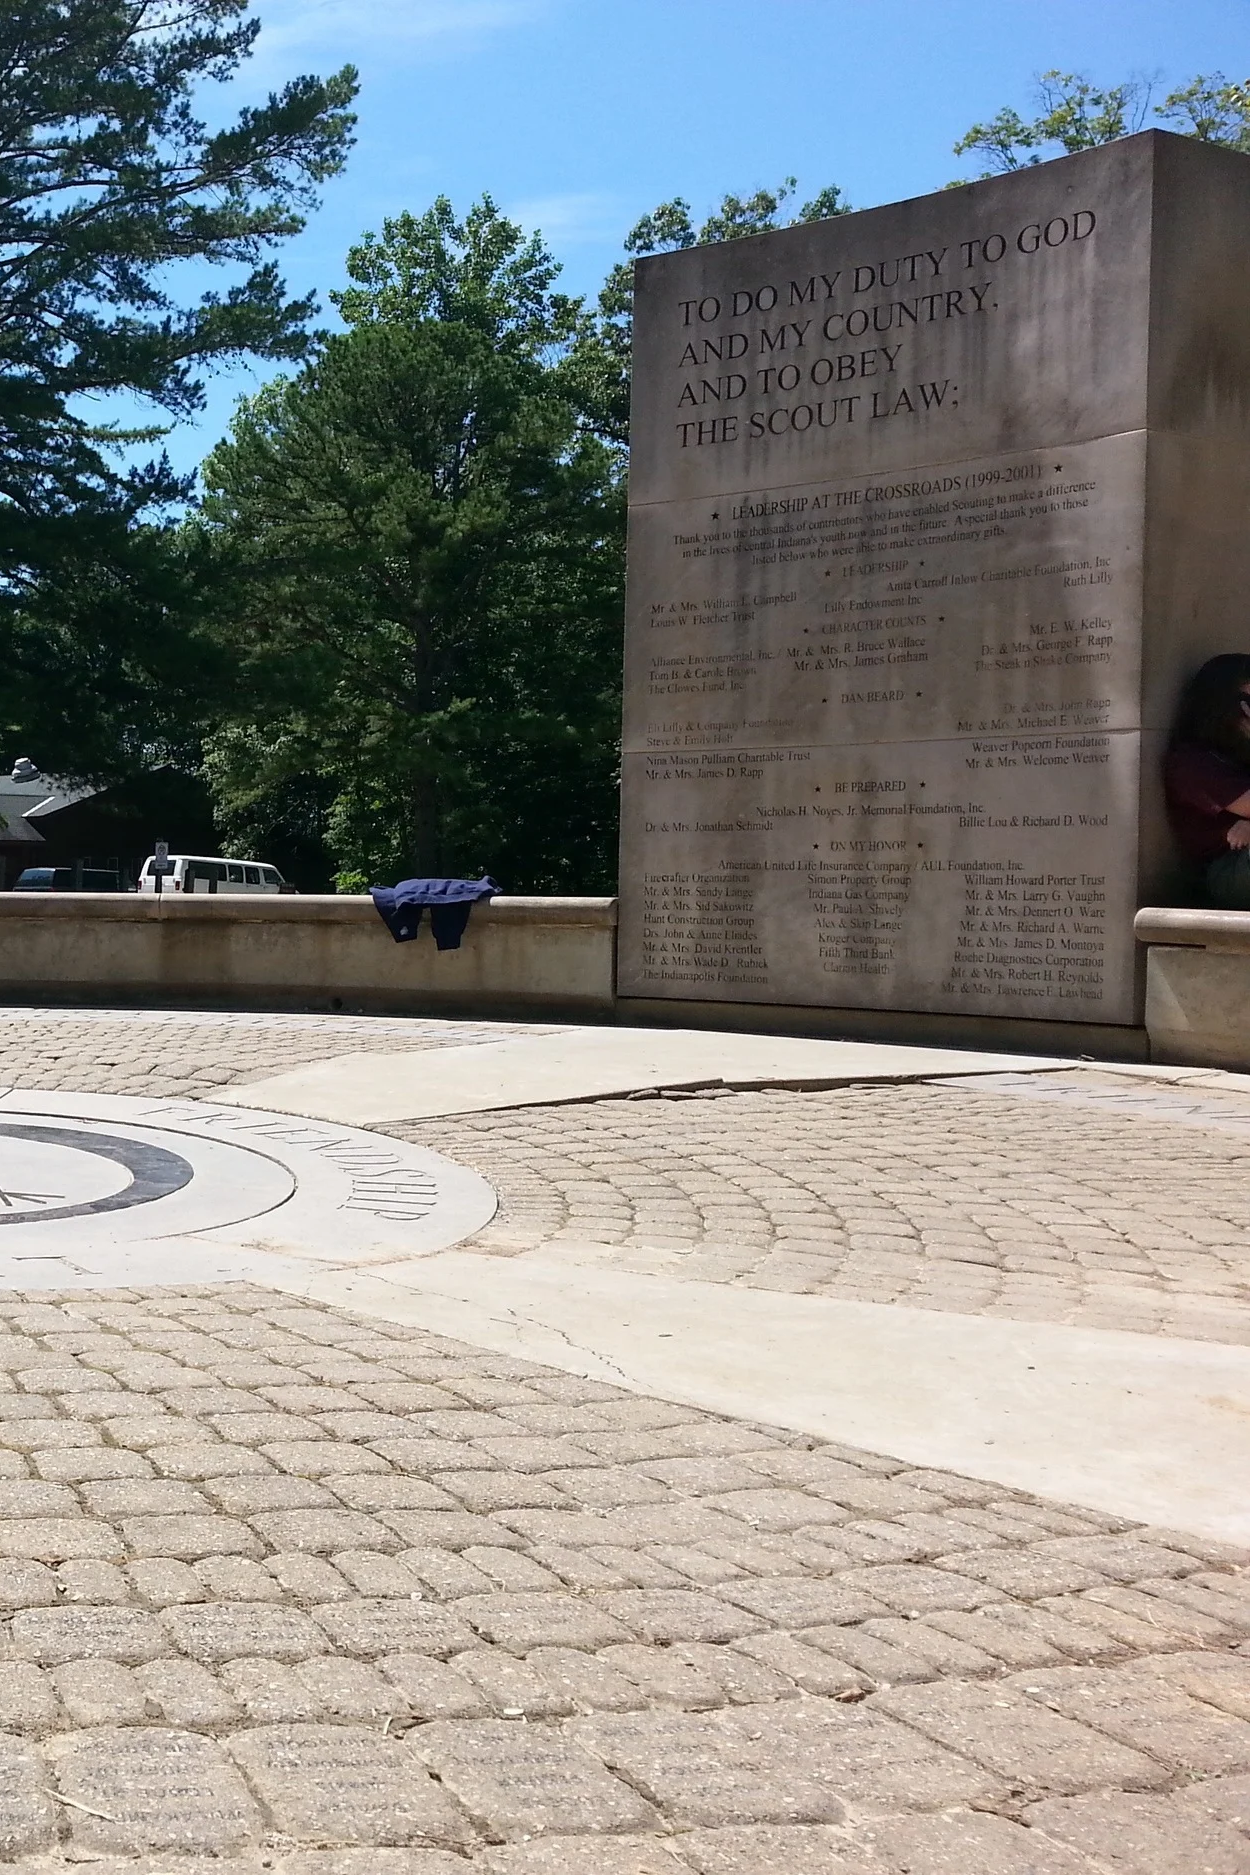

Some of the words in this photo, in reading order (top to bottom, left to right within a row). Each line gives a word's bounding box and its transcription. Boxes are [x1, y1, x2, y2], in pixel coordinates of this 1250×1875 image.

[677, 296, 720, 327] TO
[731, 284, 778, 317] DO
[789, 270, 841, 307] MY
[853, 246, 948, 294] DUTY
[960, 233, 1006, 269] TO
[1016, 209, 1096, 254] GOD
[677, 332, 749, 368] AND
[758, 319, 812, 354] MY
[822, 280, 998, 342] COUNTRY,
[676, 373, 747, 408] AND
[756, 363, 801, 394] TO
[810, 342, 903, 386] OBEY
[675, 415, 738, 448] THE
[749, 395, 860, 439] SCOUT
[869, 378, 958, 419] LAW;
[732, 497, 808, 520] LEADERSHIP
[811, 493, 830, 509] AT
[836, 490, 862, 506] THE
[864, 475, 961, 503] CROSSROADS
[964, 463, 1041, 488] (1999-2001)
[674, 533, 700, 545] Thank
[703, 532, 720, 544] you
[721, 531, 731, 540] to
[733, 528, 745, 538] the
[749, 522, 794, 537] thousands
[796, 521, 806, 531] of
[808, 516, 863, 530] contributors
[865, 510, 886, 521] who
[888, 509, 910, 519] have
[912, 501, 949, 516] enabled
[952, 497, 994, 510] Scouting
[996, 495, 1006, 504] to
[1008, 489, 1035, 502] make
[1037, 490, 1043, 498] a
[1045, 481, 1096, 496] difference
[682, 550, 691, 558] in
[693, 546, 705, 557] the
[709, 545, 730, 555] lives
[732, 543, 741, 553] of
[744, 541, 774, 552] central
[777, 535, 817, 548] Indiana's
[819, 530, 846, 546] youth
[848, 529, 866, 539] now
[870, 524, 887, 537] and
[889, 525, 899, 534] in
[901, 521, 915, 532] the
[955, 514, 962, 525] A
[963, 509, 997, 526] special
[1000, 505, 1026, 520] thank
[1029, 505, 1047, 518] you
[1049, 502, 1060, 511] to
[1062, 498, 1088, 509] those
[752, 552, 776, 565] listed
[778, 550, 805, 562] below
[809, 547, 828, 559] who
[831, 546, 853, 556] were
[855, 541, 875, 553] able
[877, 541, 887, 551] to
[889, 537, 914, 549] make
[917, 530, 980, 546] extraordinary
[842, 560, 909, 577] LEADERSHIP
[951, 573, 976, 585] Inlow
[980, 568, 1031, 581] Charitable
[1063, 574, 1086, 587] Ruth
[1089, 570, 1112, 585] Lilly
[849, 597, 904, 610] Endowment
[821, 618, 882, 634] CHARACTER
[885, 614, 926, 629] COUNTS
[1080, 616, 1111, 630] Kelley
[856, 641, 884, 652] Bruce
[887, 636, 925, 648] Wallace
[1036, 639, 1072, 650] George
[1087, 634, 1113, 648] Rapp
[853, 655, 884, 667] James
[886, 650, 928, 663] Graham
[841, 692, 863, 703] DAN
[866, 690, 904, 702] BEARD
[972, 741, 1008, 752] Weaver
[1011, 739, 1051, 753] Popcorn
[1054, 735, 1110, 749] Foundation
[646, 755, 667, 765] Nina
[669, 755, 699, 765] Mason
[701, 753, 735, 764] Pulliam
[737, 751, 784, 763] Charitable
[788, 750, 810, 761] Trust
[1022, 754, 1069, 765] Welcome
[1071, 752, 1110, 763] Weaver
[697, 767, 724, 778] James
[739, 766, 763, 779] Rapp
[834, 782, 845, 793] BE
[851, 780, 906, 792] PREPARED
[756, 805, 796, 817] Nicholas
[846, 804, 857, 816] Jr.
[860, 803, 906, 815] Memorial
[908, 802, 965, 814] Foundation,
[968, 801, 986, 813] Inc.
[694, 820, 733, 832] Jonathan
[735, 820, 773, 831] Schmidt
[958, 816, 985, 827] Billie
[987, 815, 1007, 827] Lou
[1009, 816, 1018, 826] &
[1022, 815, 1060, 826] Richard
[1063, 814, 1075, 826] D.
[1078, 813, 1108, 825] Wood
[830, 840, 845, 850] ON
[849, 840, 863, 851] MY
[868, 840, 906, 851] HONOR
[720, 859, 761, 870] American
[763, 860, 795, 870] United
[797, 859, 817, 871] Life
[819, 860, 863, 871] Insurance
[865, 860, 910, 873] Company
[920, 860, 945, 871] AUL
[947, 859, 1005, 871] Foundation,
[1007, 859, 1026, 870] Inc.
[807, 873, 837, 884] Simon
[840, 873, 877, 887] Property
[880, 874, 912, 888] Group
[964, 873, 1003, 885] William
[1005, 874, 1044, 885] Howard
[1046, 873, 1076, 885] Porter
[1080, 873, 1105, 885] Trust
[643, 913, 665, 924] Hunt
[666, 914, 723, 925] Construction
[725, 916, 754, 928] Group
[953, 950, 984, 963] Roche
[986, 952, 1043, 966] Diagnostics
[1044, 953, 1104, 969] Corporation
[643, 968, 659, 979] The
[660, 969, 715, 983] Indianapolis
[716, 971, 768, 984] Foundation
[136, 1106, 440, 1221] FRIENDSHIP
